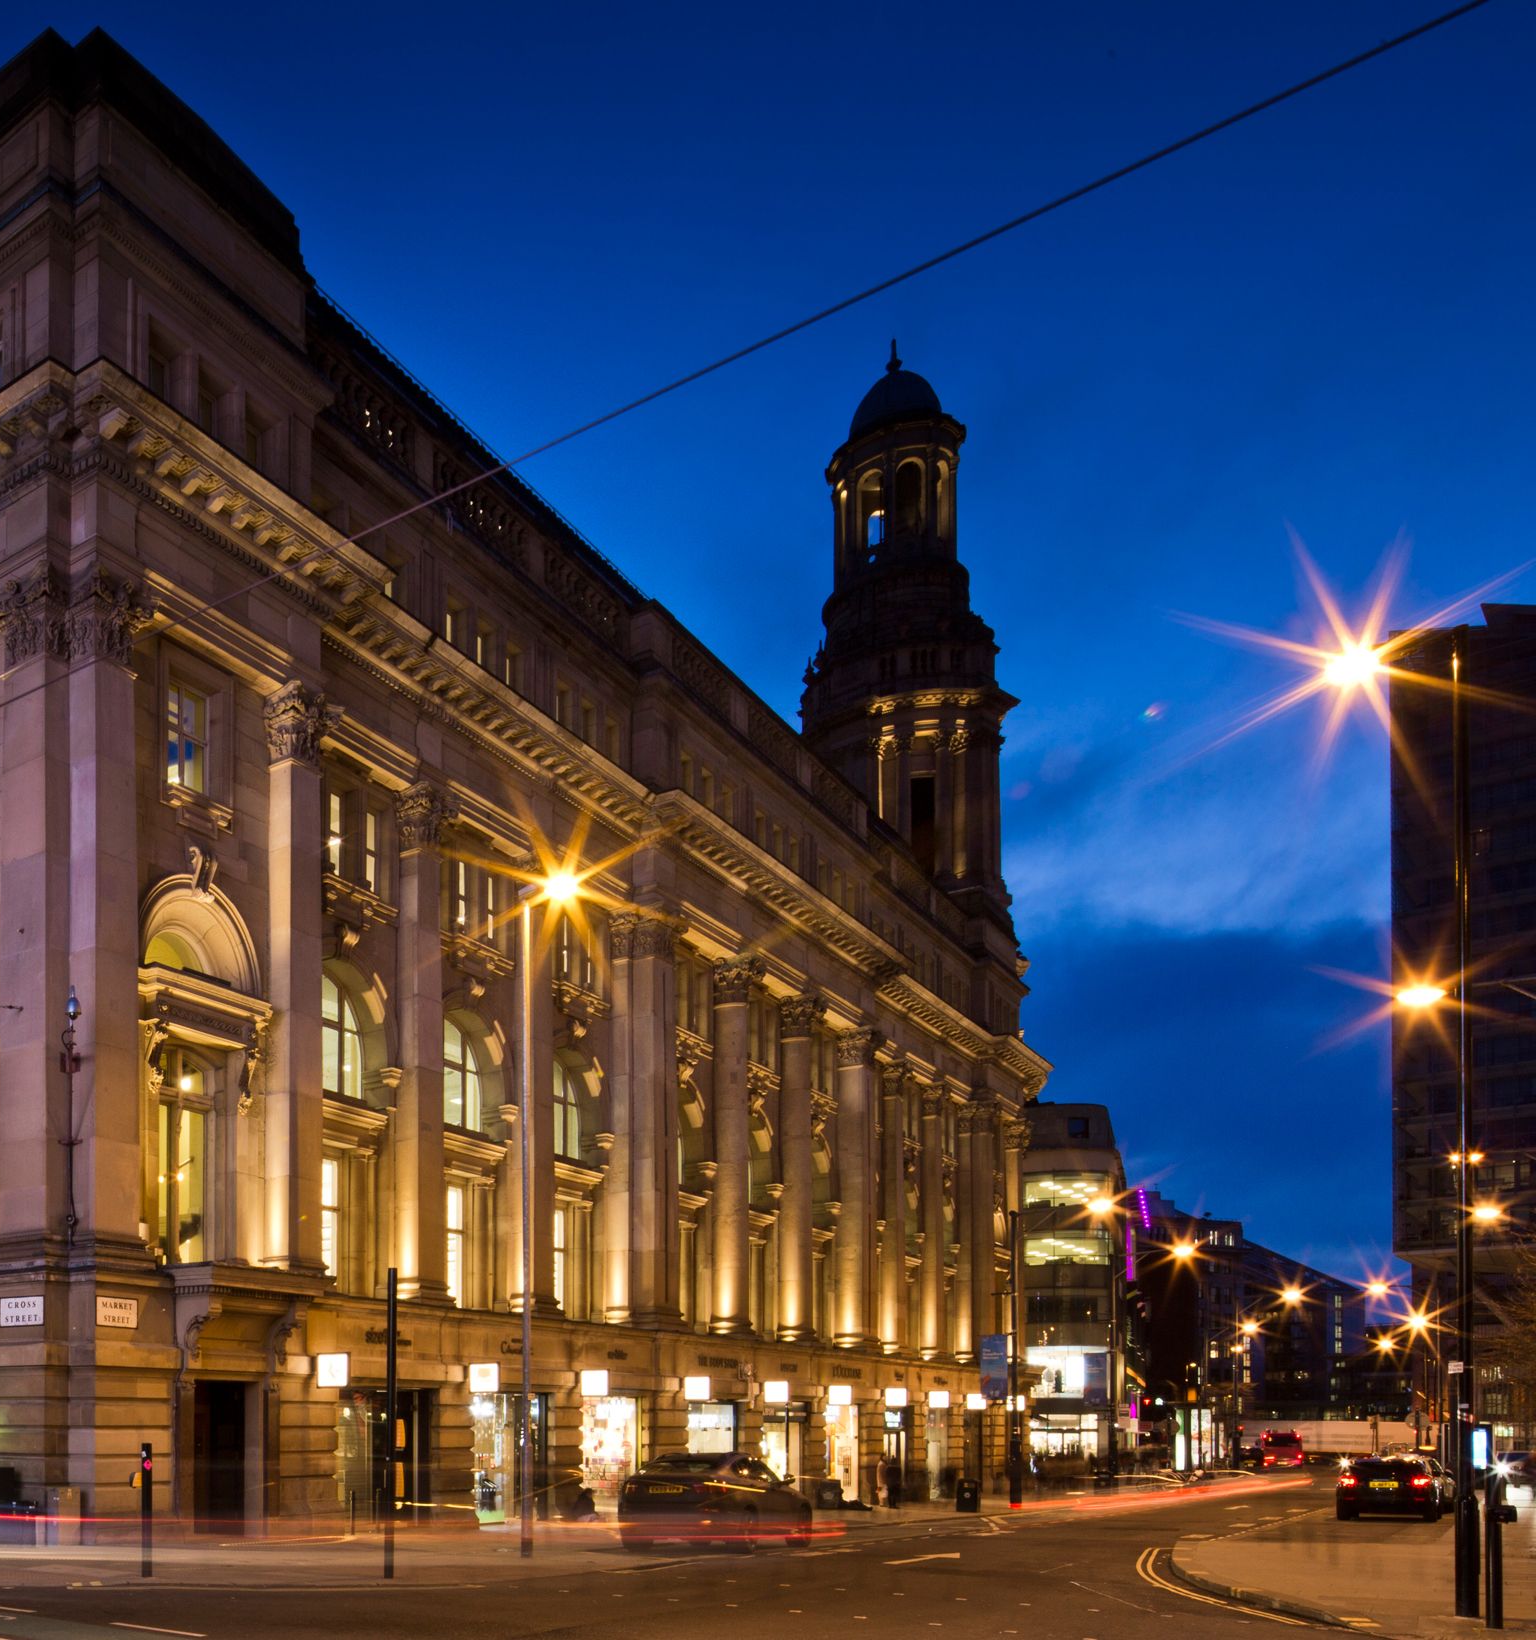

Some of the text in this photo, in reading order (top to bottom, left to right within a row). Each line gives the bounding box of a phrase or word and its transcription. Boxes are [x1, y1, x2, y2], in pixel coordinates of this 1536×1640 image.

[7, 1301, 37, 1309] CROSS
[101, 1301, 133, 1311] MARKET
[4, 1314, 38, 1323] STREET
[103, 1314, 130, 1324] STREET
